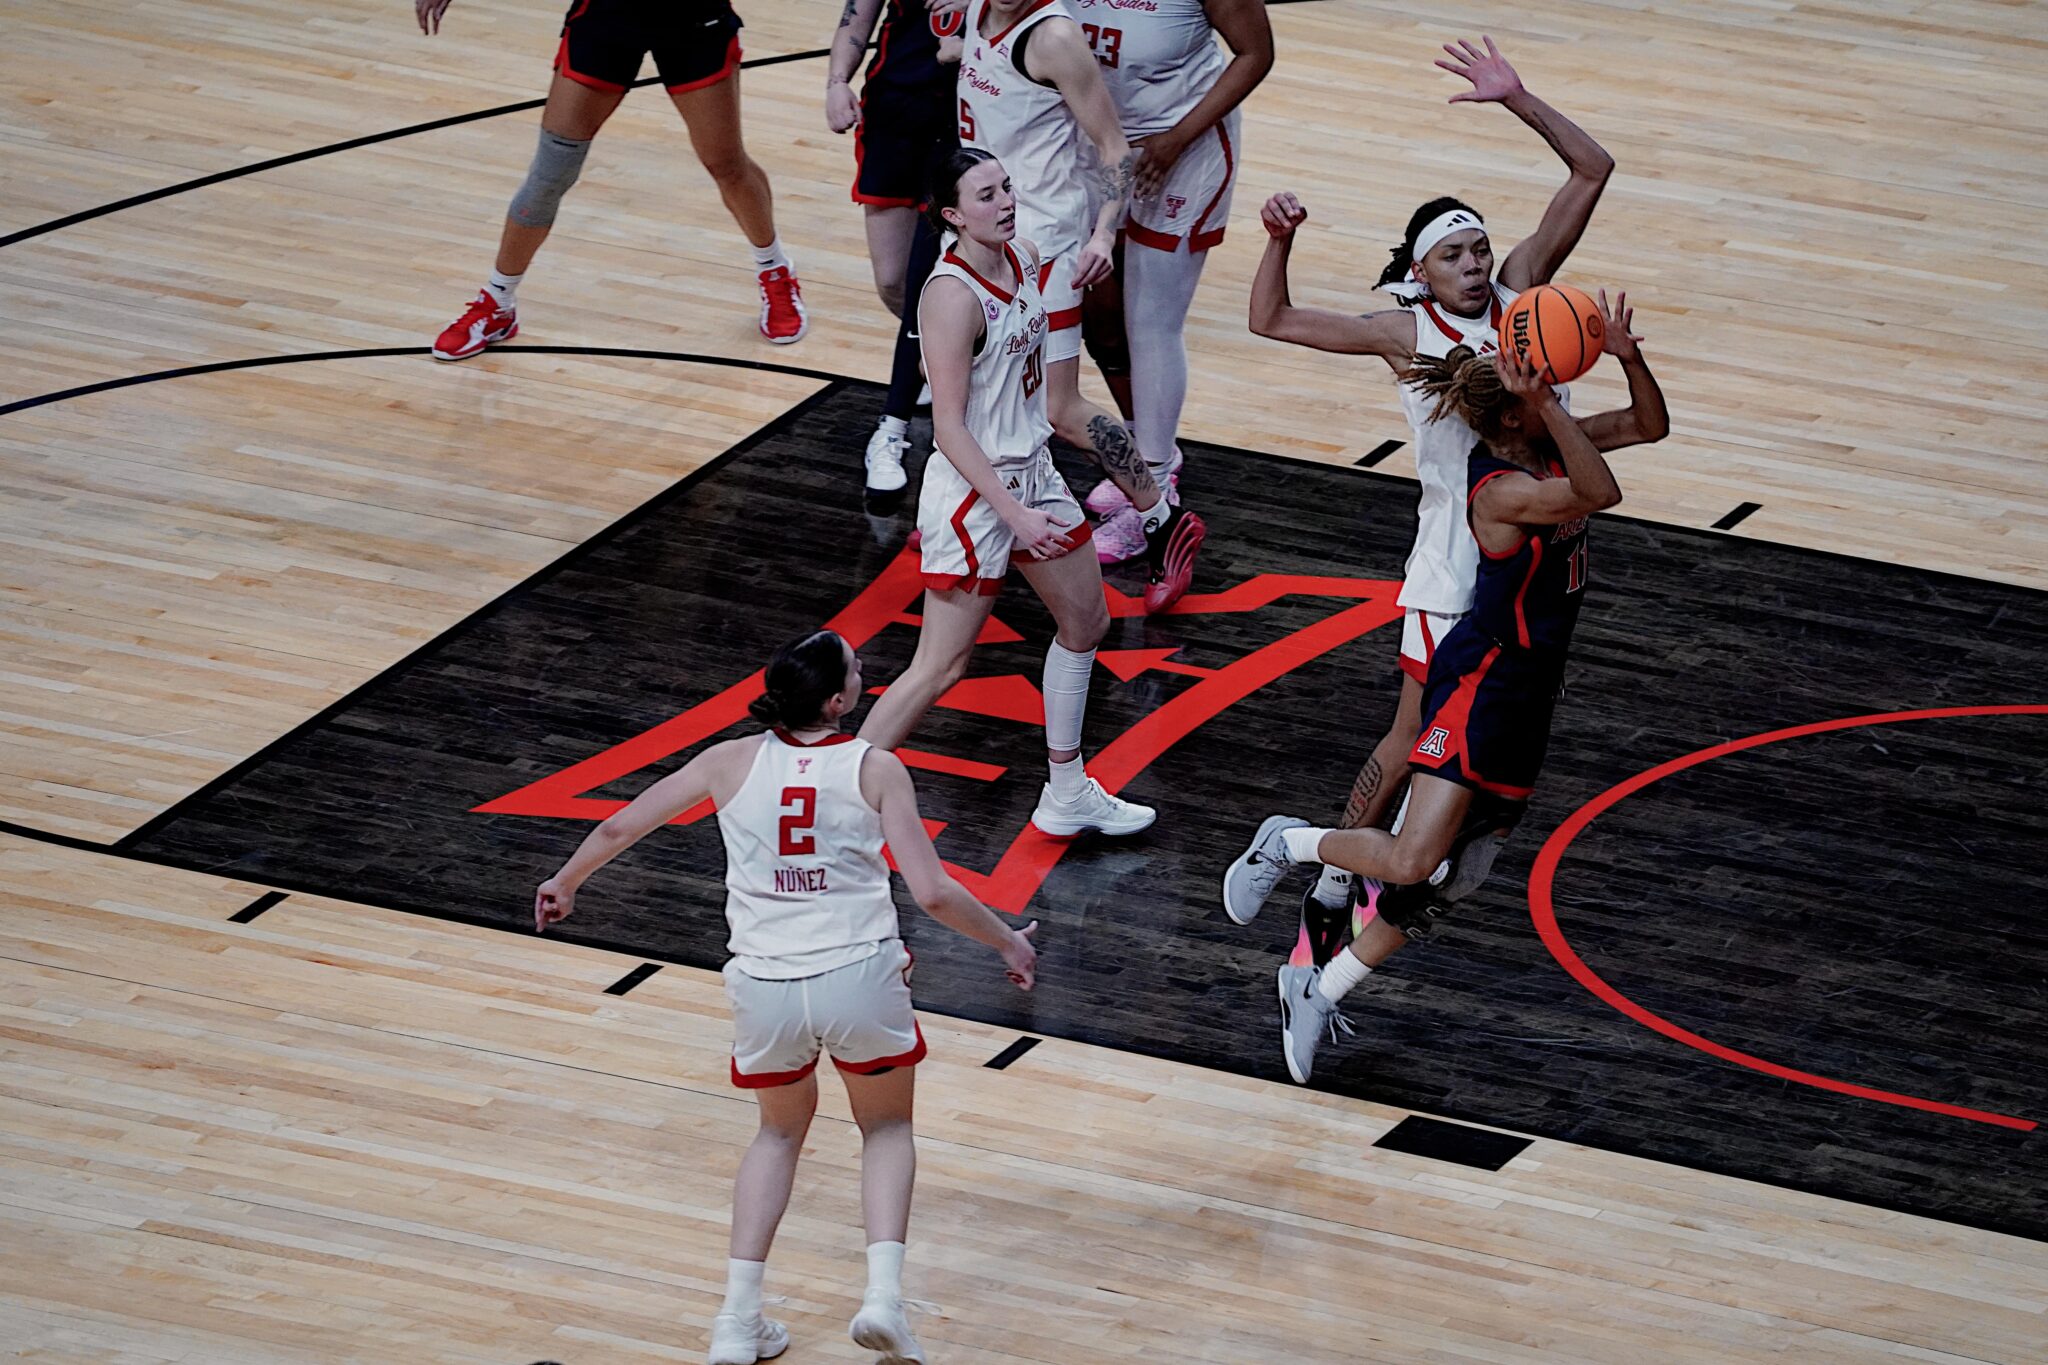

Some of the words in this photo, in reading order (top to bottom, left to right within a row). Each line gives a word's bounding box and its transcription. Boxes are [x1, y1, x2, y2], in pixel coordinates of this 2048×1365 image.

[1006, 328, 1031, 355] Lady
[1021, 343, 1043, 400] 20
[1566, 534, 1588, 594] 11
[1417, 726, 1449, 759] A
[779, 787, 816, 856] 2
[774, 865, 828, 893] NÚÑEZ
